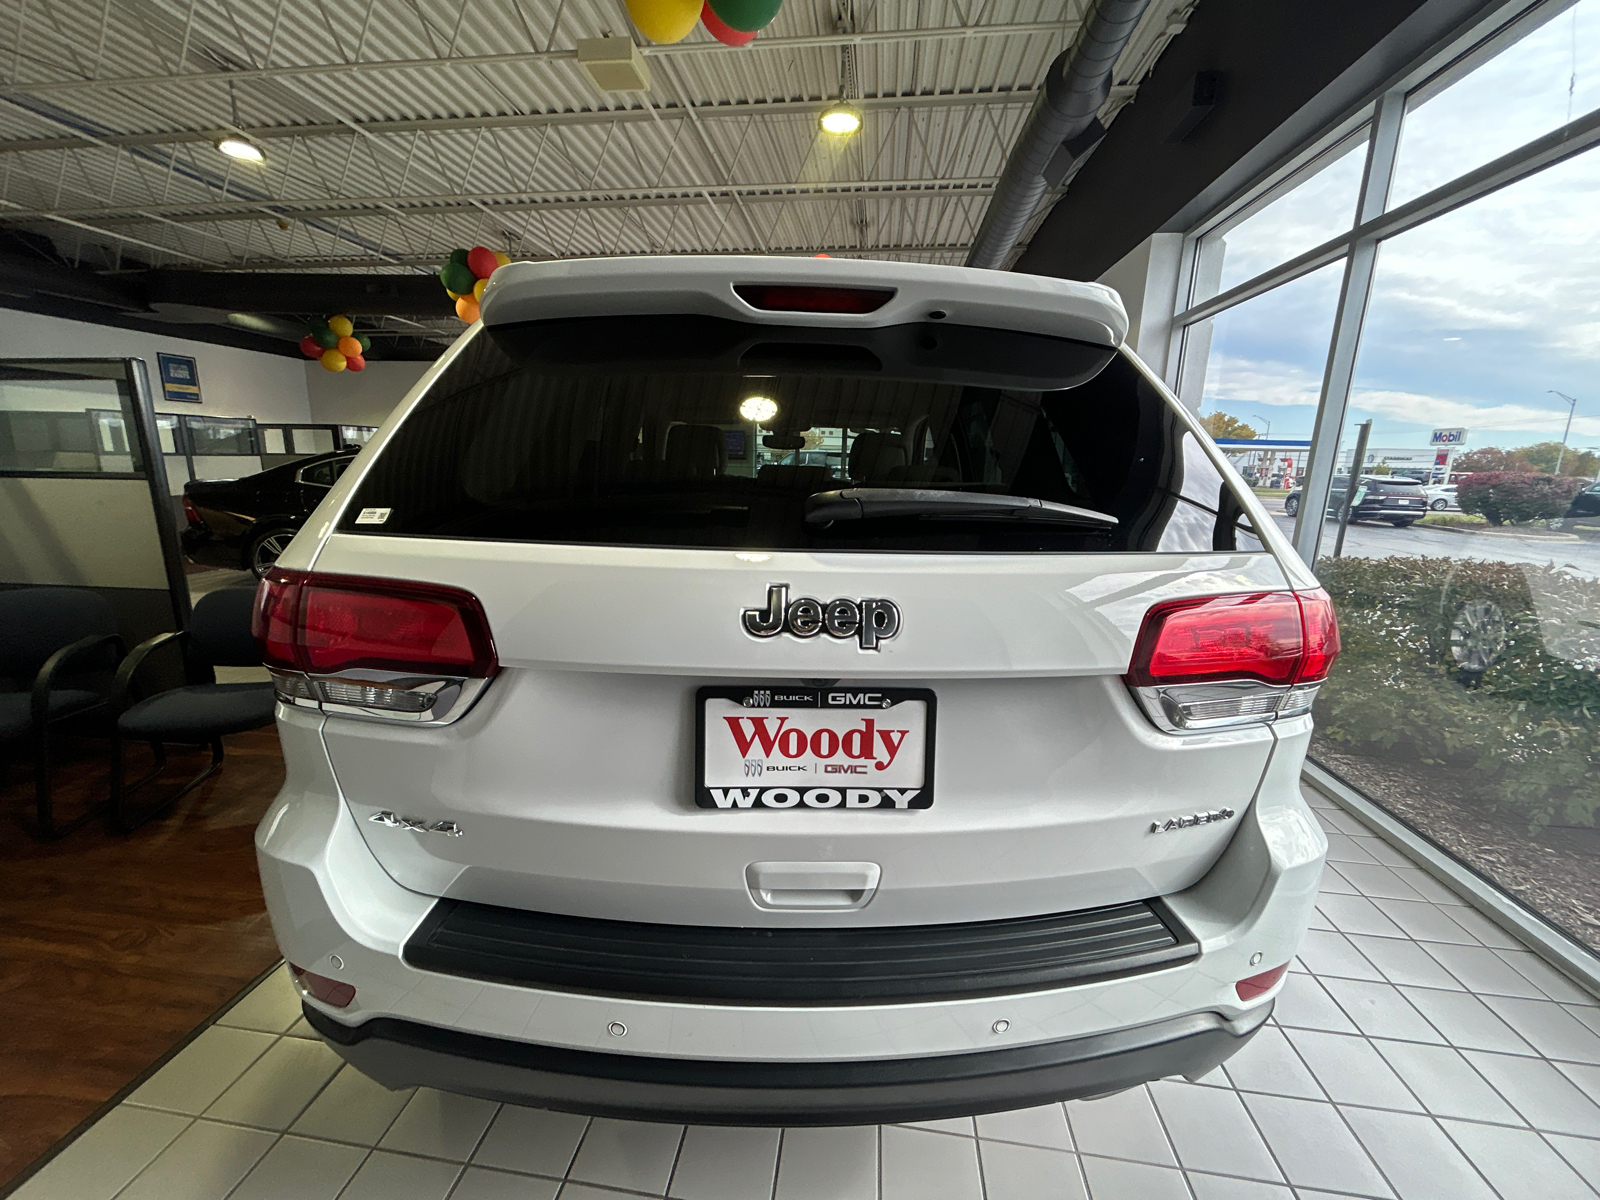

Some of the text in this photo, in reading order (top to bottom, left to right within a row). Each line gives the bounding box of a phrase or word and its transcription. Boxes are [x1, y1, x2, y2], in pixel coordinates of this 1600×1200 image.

[1432, 431, 1462, 443] Mobil
[740, 583, 903, 653] Jeep
[774, 692, 883, 706] BUICK GMC
[722, 716, 910, 771] Woody
[824, 764, 868, 775] GMC
[709, 788, 922, 809] WOODY
